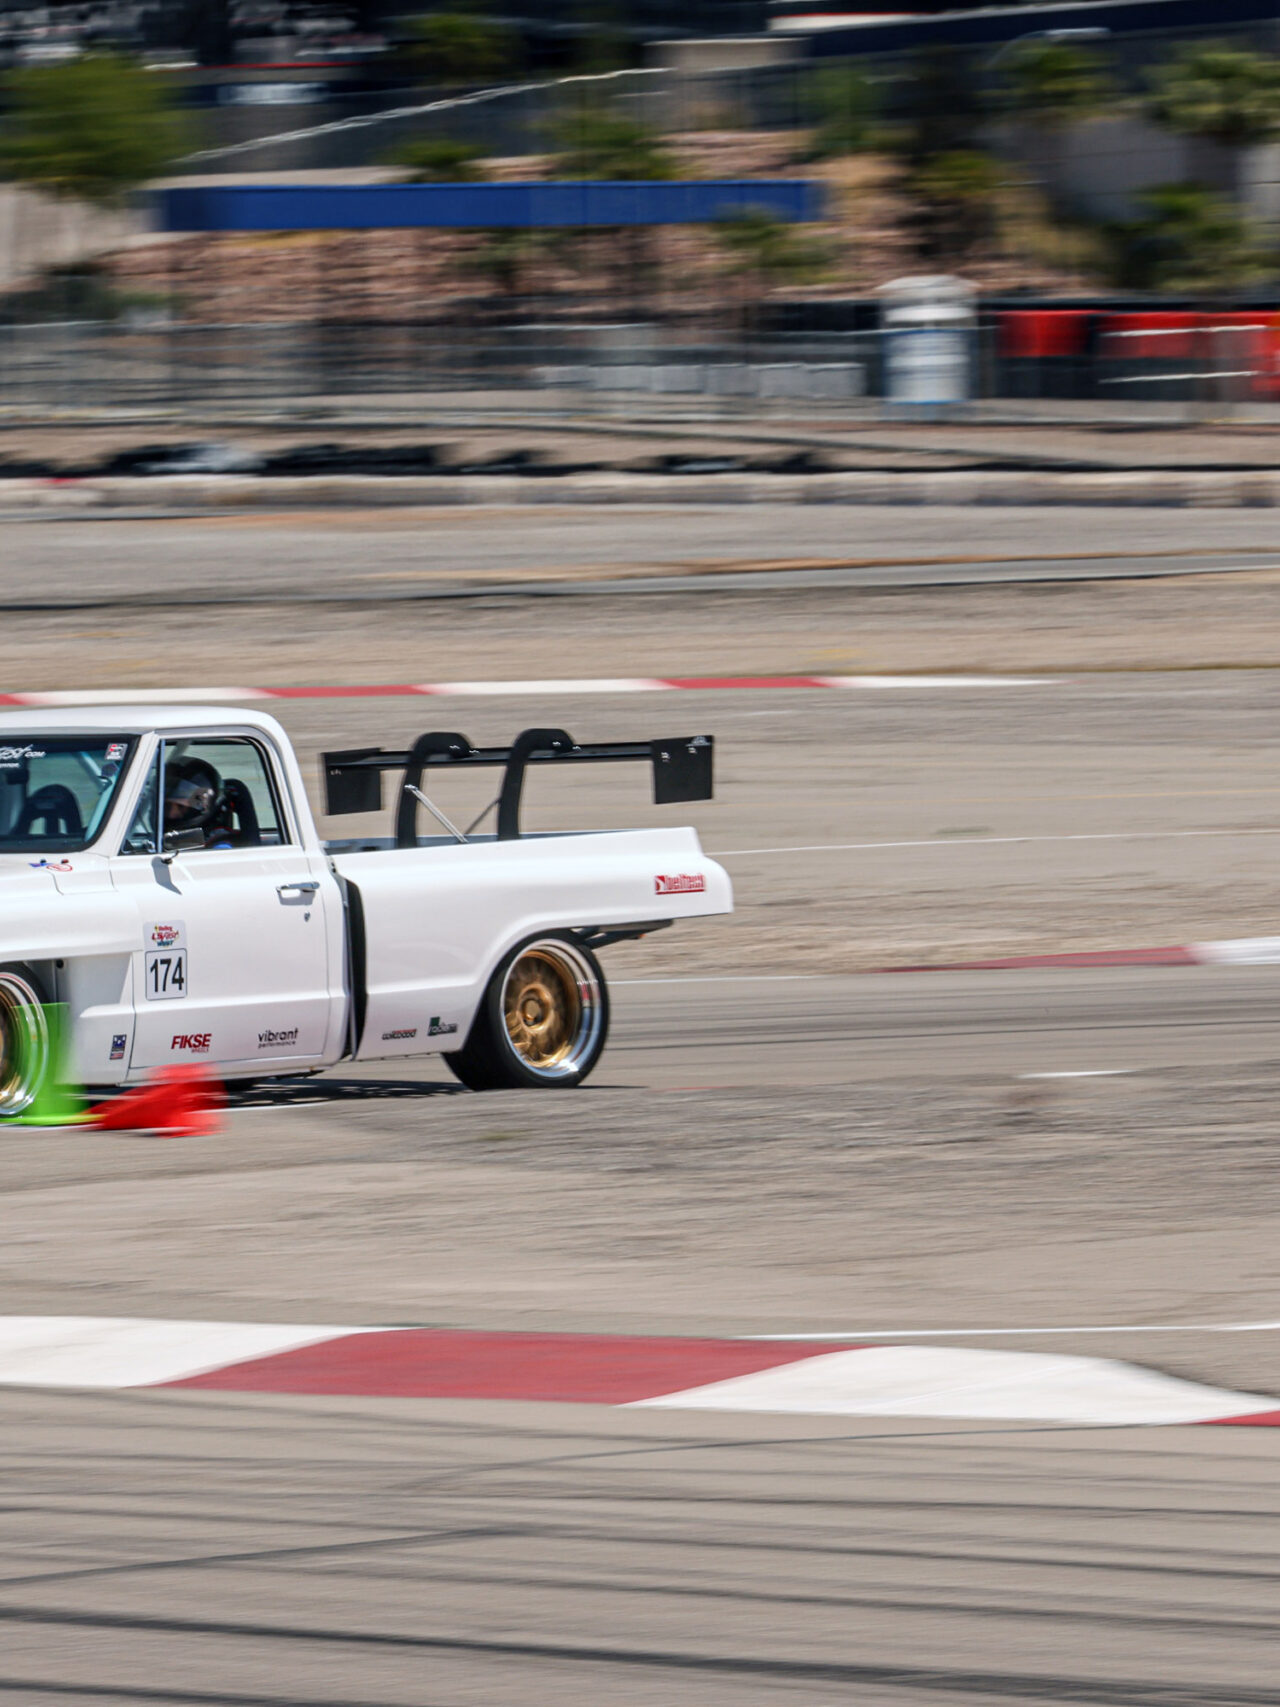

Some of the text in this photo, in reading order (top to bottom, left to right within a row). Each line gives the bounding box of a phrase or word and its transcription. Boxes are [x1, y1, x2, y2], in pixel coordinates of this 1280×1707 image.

[150, 956, 184, 993] 174
[171, 1033, 212, 1049] FIKSE
[258, 1027, 298, 1042] vibrant
